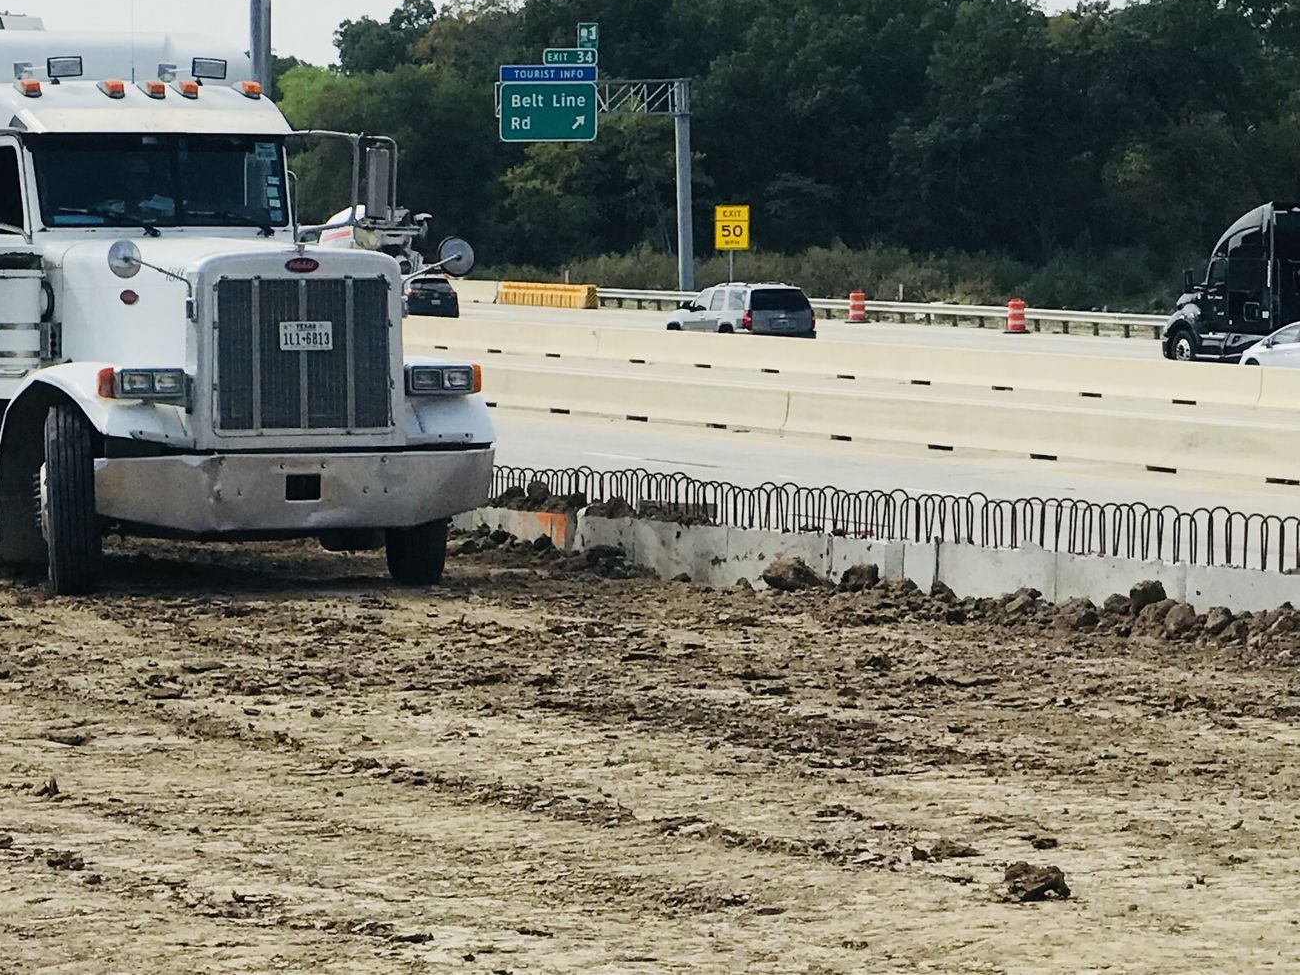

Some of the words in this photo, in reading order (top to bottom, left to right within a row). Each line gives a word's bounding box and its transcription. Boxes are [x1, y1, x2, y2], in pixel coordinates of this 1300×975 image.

[547, 52, 568, 61] EXIT
[577, 51, 593, 63] 34
[514, 69, 555, 78] TOURIST
[560, 69, 584, 78] INFO
[511, 93, 544, 107] Belt
[552, 93, 586, 107] Line
[511, 116, 531, 129] Rd
[721, 225, 743, 237] 50
